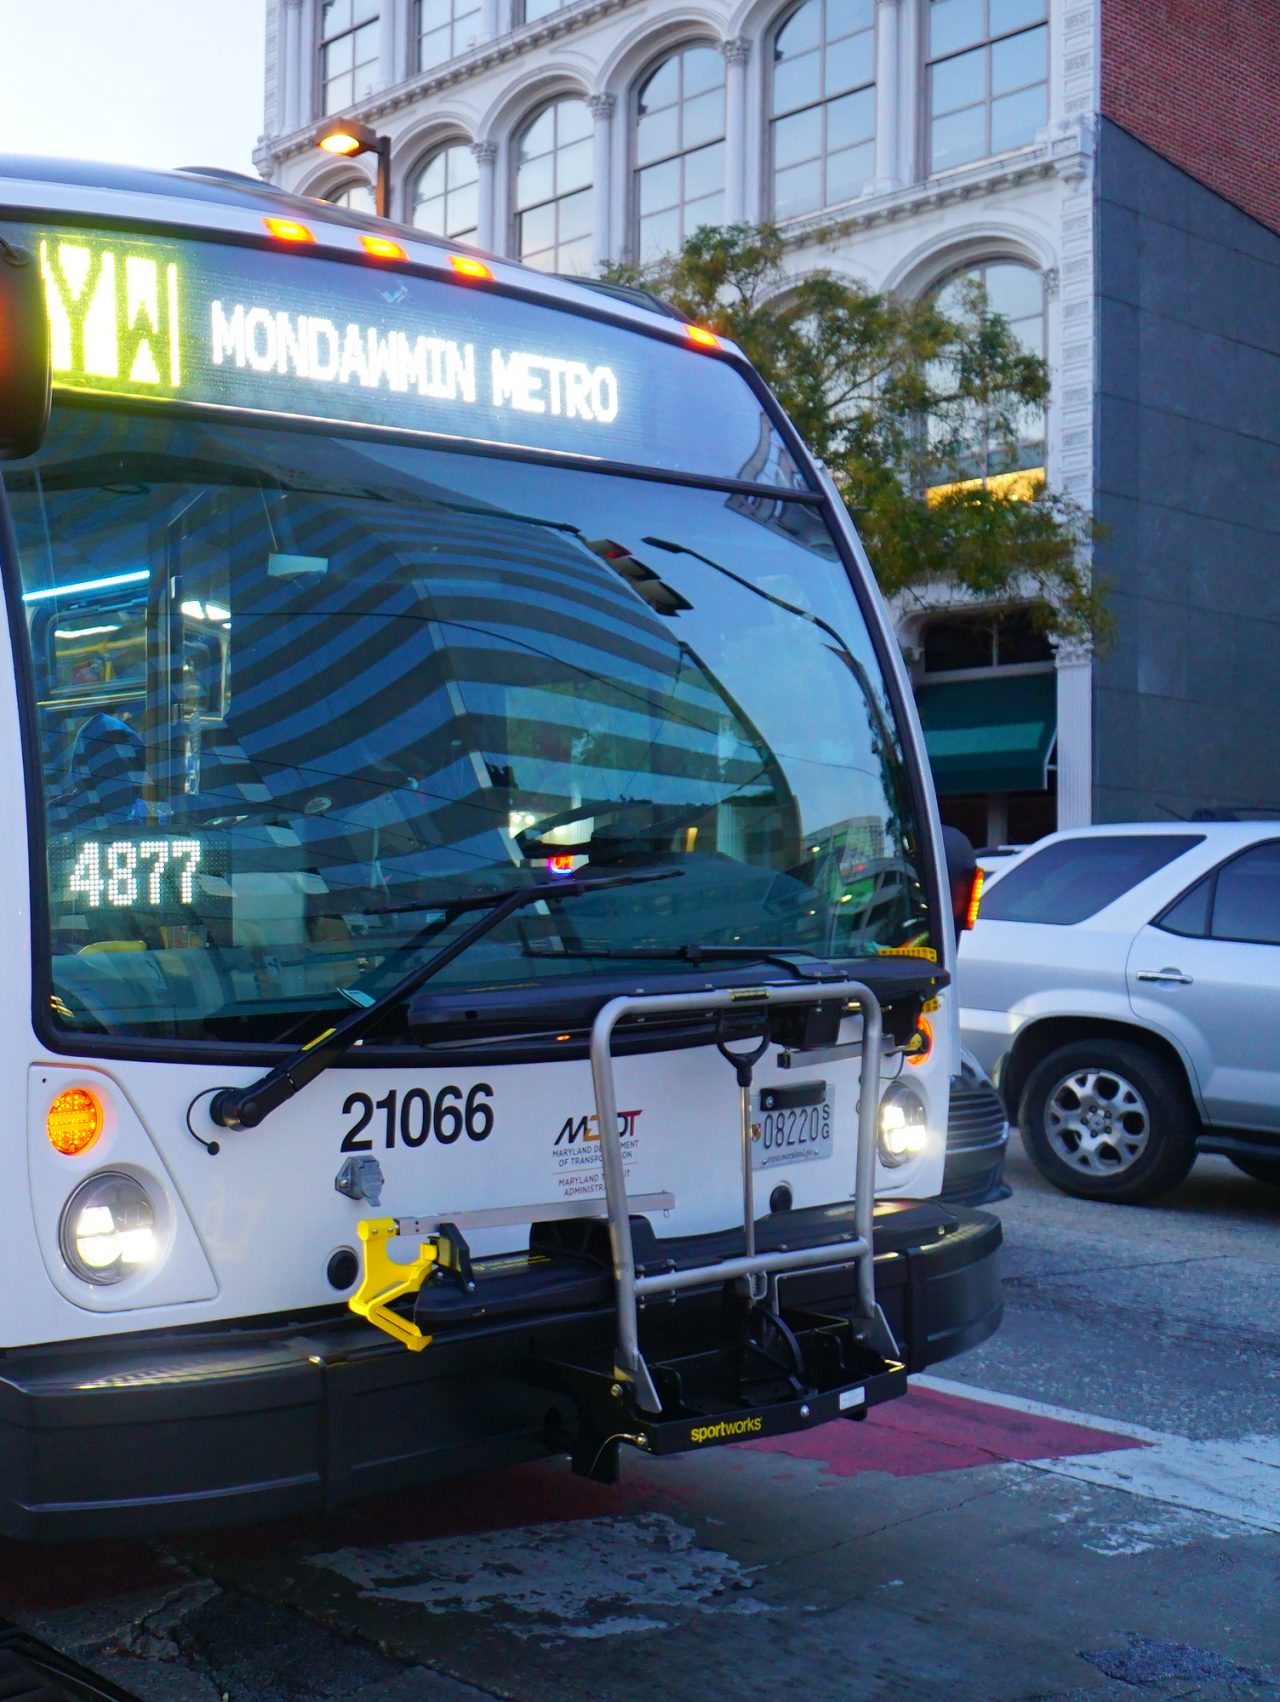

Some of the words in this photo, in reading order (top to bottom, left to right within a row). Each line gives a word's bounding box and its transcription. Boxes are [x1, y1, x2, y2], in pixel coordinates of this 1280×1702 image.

[211, 299, 477, 402] MONDAWMIN
[491, 327, 620, 423] METRO
[70, 840, 201, 907] 4877
[340, 1083, 494, 1152] 21066
[764, 1107, 819, 1149] 08220
[553, 1144, 592, 1158] MARYLAND
[559, 1159, 568, 1167] OF
[571, 1151, 632, 1165] TRANSPOON
[559, 1174, 599, 1187] MARYLAND
[564, 1184, 606, 1197] ADMINISTR
[691, 1417, 761, 1443] sportworks
